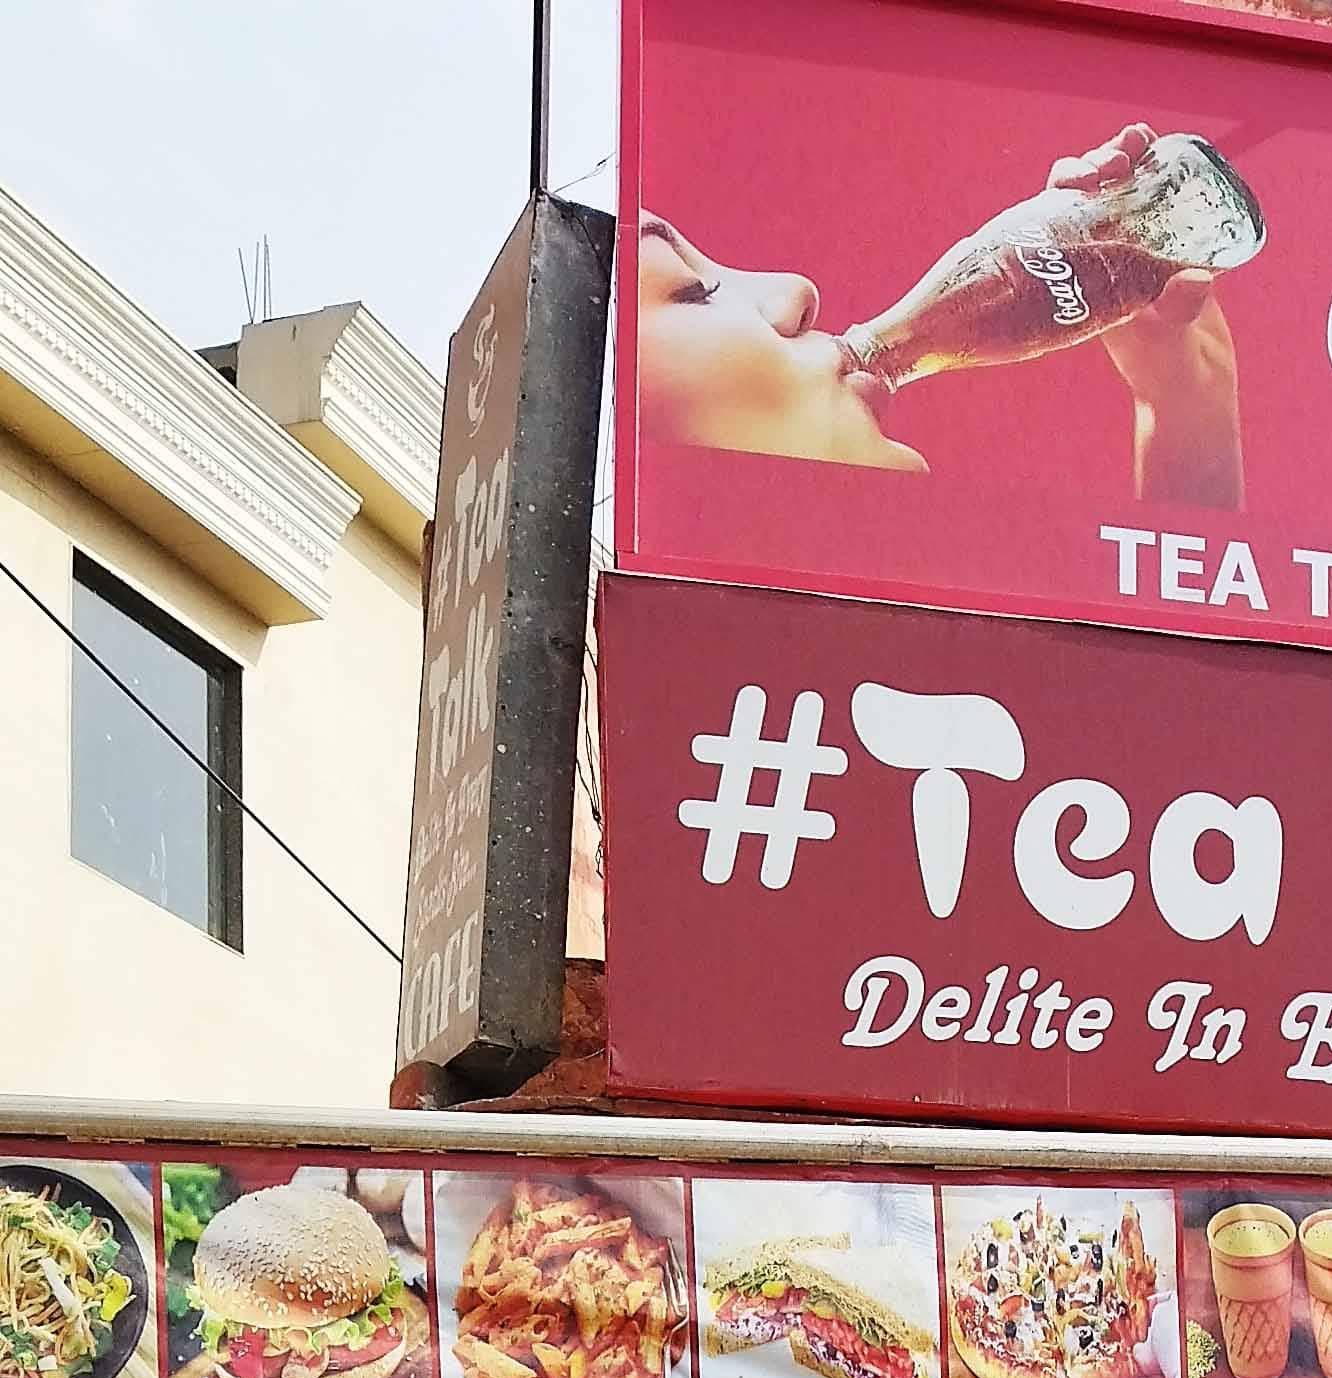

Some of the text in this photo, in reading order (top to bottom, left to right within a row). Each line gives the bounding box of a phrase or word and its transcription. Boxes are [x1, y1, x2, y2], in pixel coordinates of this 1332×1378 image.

[1099, 525, 1270, 612] TEA
[678, 682, 1285, 946] #Tea
[842, 955, 1113, 1052] Delite
[1147, 980, 1246, 1073] In
